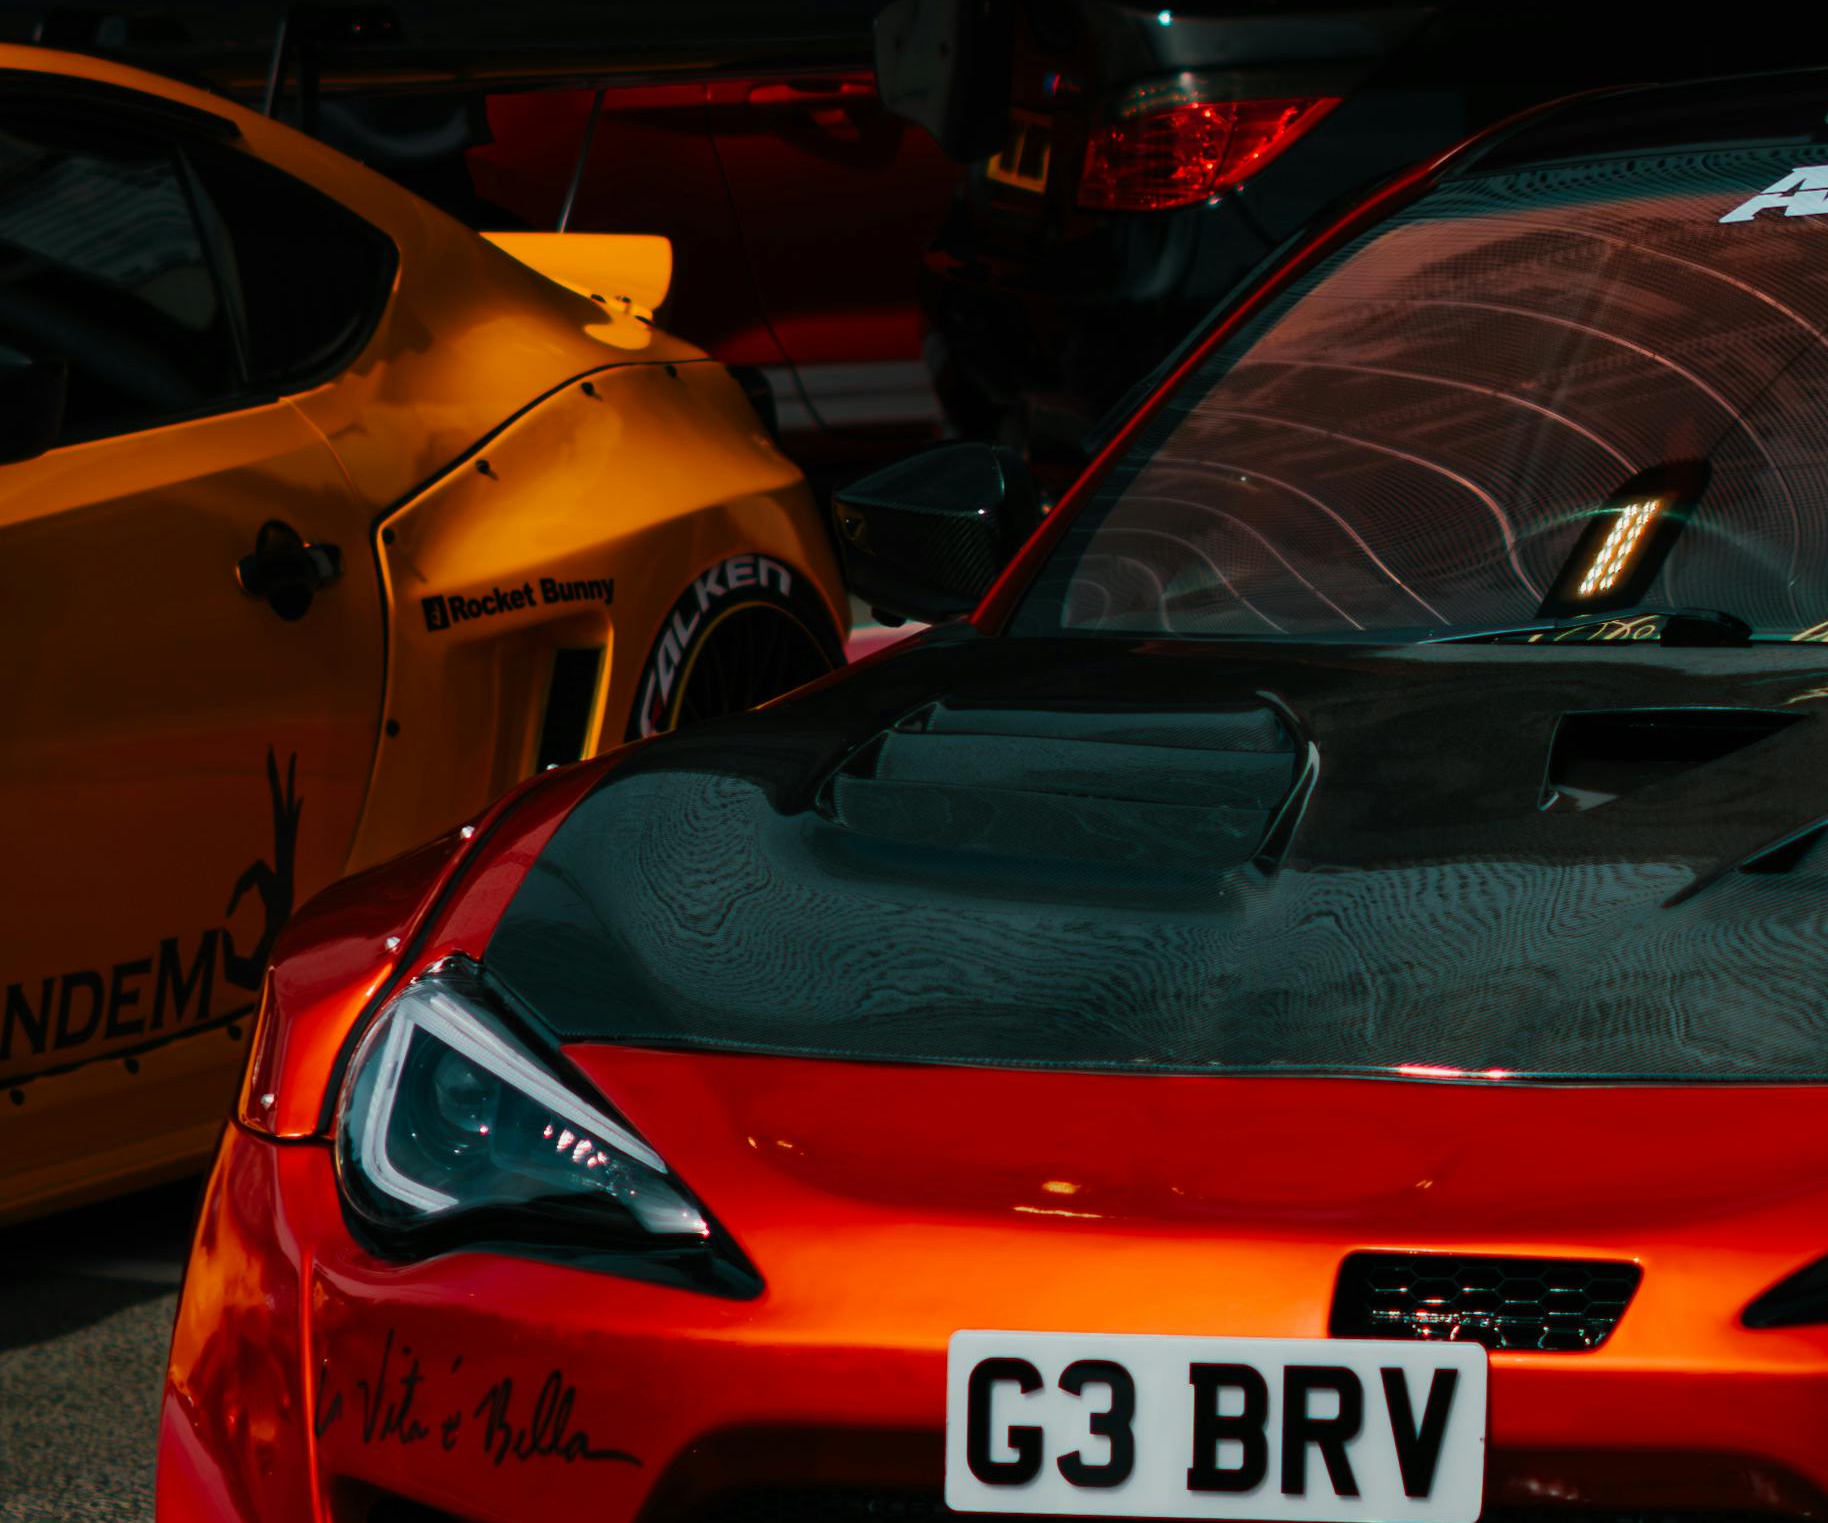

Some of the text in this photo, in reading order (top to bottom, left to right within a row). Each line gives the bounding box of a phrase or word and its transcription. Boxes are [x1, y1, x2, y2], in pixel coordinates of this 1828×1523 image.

[448, 578, 614, 623] Rocket Bunny
[967, 1358, 1459, 1498] G3 BRV
